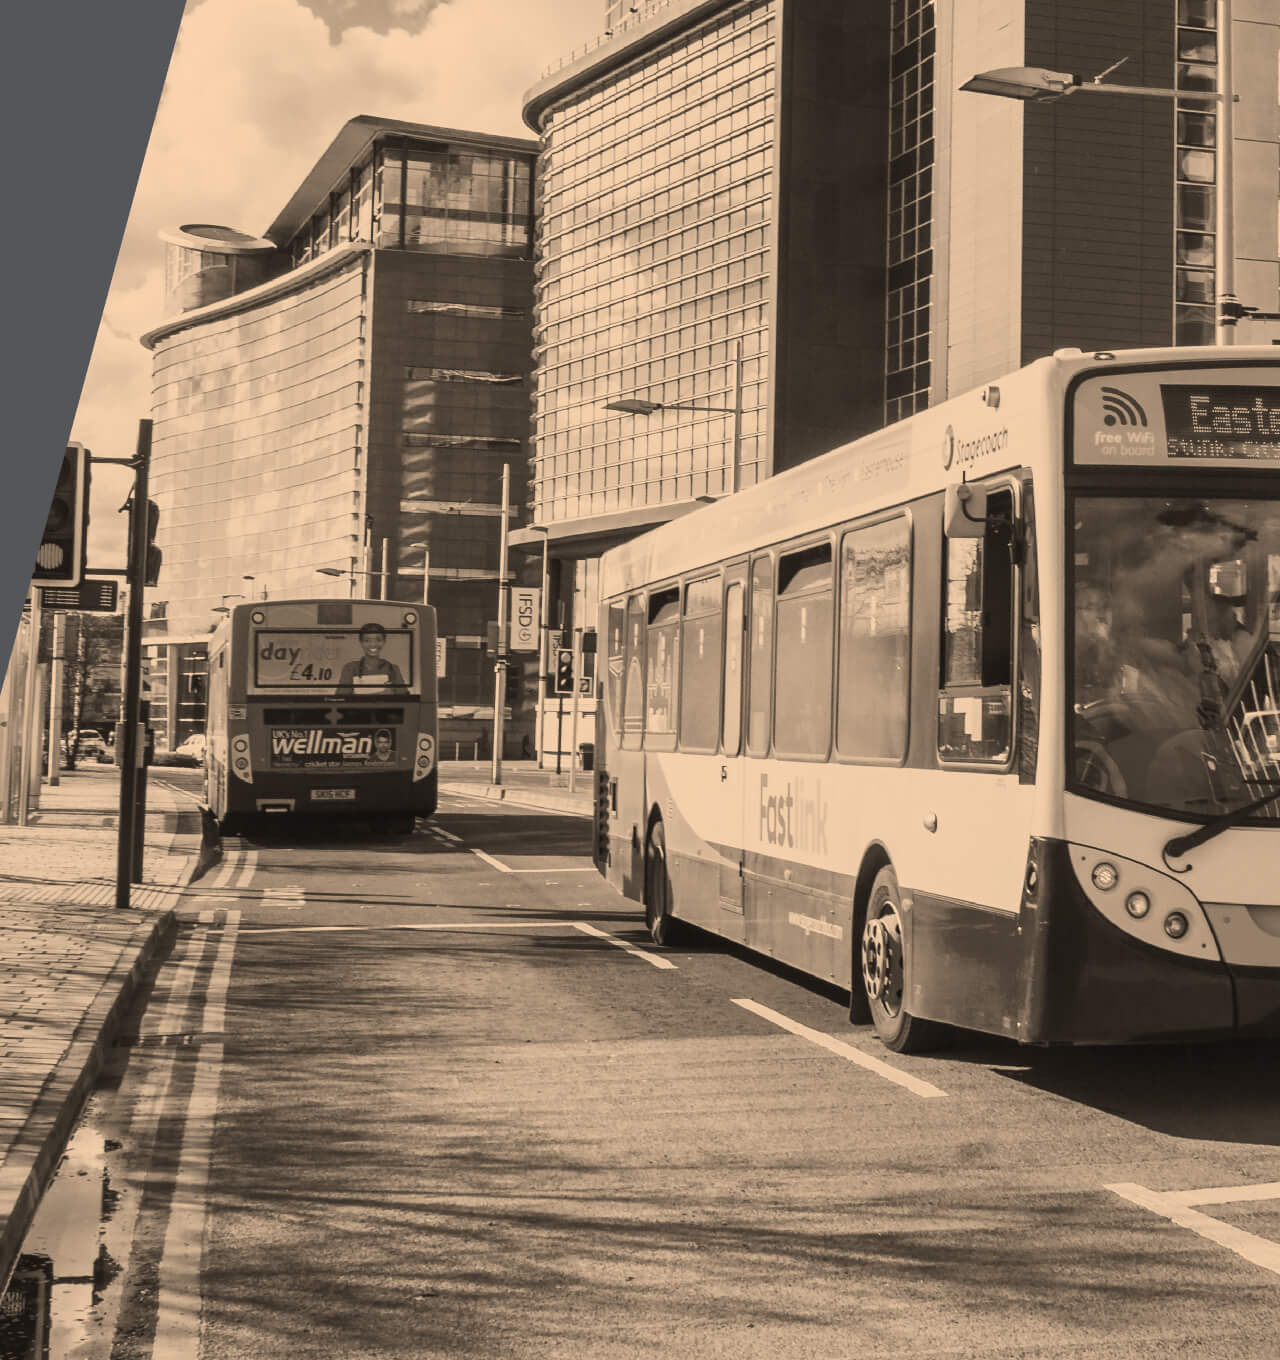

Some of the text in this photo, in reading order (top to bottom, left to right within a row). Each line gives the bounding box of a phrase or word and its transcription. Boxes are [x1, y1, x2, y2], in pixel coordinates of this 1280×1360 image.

[955, 425, 1009, 469] Stagecoach
[1094, 430, 1122, 446] free
[1101, 444, 1155, 456] on board
[519, 593, 533, 627] IFSD
[289, 663, 333, 681] £4.10
[272, 729, 373, 755] wellman
[760, 772, 829, 857] Fastlink
